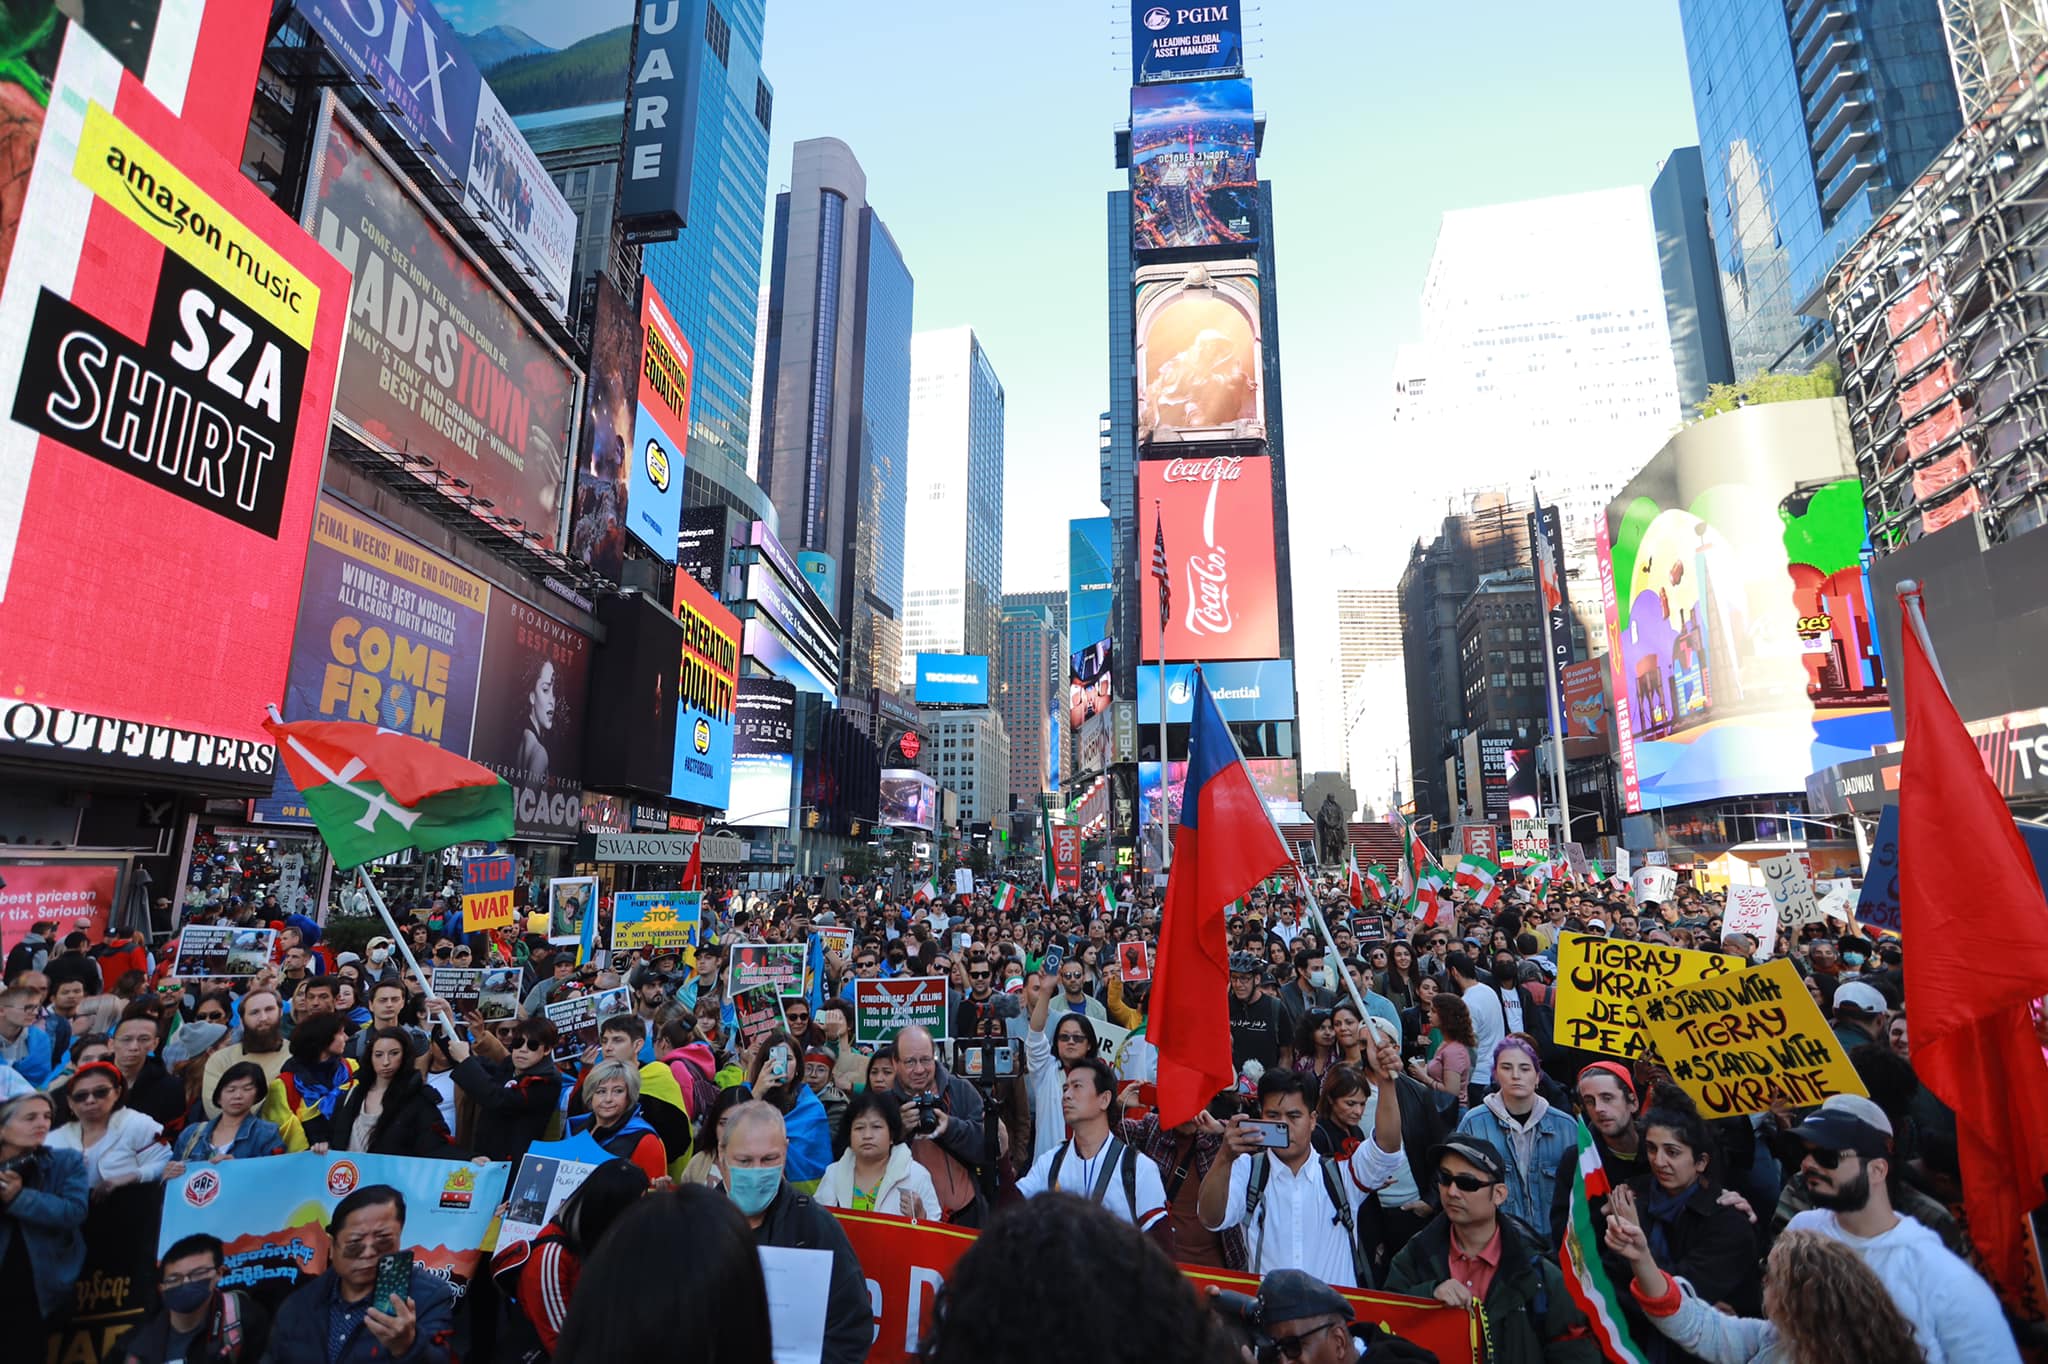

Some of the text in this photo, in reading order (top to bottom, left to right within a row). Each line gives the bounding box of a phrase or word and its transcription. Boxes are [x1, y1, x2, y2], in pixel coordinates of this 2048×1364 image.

[1177, 6, 1228, 25] PGIM
[1153, 34, 1221, 48] A LEADING GLOBAL
[1155, 47, 1180, 58] ASSET
[365, 45, 383, 77] THE
[388, 75, 428, 131] MUSICAL
[107, 145, 301, 314] amazon music
[532, 222, 568, 281] WRONG
[360, 216, 499, 366] COME SEE HOW THE WORLD COULD
[171, 289, 281, 422] SZA
[647, 321, 687, 393] GENERATION
[392, 351, 423, 386] TONY
[423, 380, 444, 406] AND
[644, 350, 685, 423] EQUALITY
[47, 331, 275, 511] SHIRT
[379, 365, 479, 461] BEST MUSICAL
[1164, 456, 1245, 483] Coca-Cola
[317, 511, 480, 602] FINAL WEEKS! MUST END OCTOBER 2
[342, 561, 456, 631] WINNER! BEST MUSICAL
[337, 584, 455, 647] ALL ACROSS NORTH AMERICA
[511, 603, 584, 651] BROADWAY'S
[515, 625, 574, 667] BEST BET
[679, 599, 737, 678] GENERATION
[329, 616, 451, 696] COME
[318, 662, 447, 742] FROM
[679, 650, 734, 726] QUALITY
[1211, 685, 1261, 700] udential
[4, 702, 275, 775] OUTFITTERS
[1119, 705, 1132, 761] HELLO!
[1481, 739, 1514, 747] EVERY
[1617, 698, 1637, 787] HERSHEY'S
[1483, 755, 1505, 763] DES
[1484, 762, 1491, 770] A
[512, 786, 580, 828] ICAGO
[637, 805, 668, 821] BLUE FIN
[1512, 819, 1548, 831] IMAGINE
[1526, 830, 1533, 839] A
[598, 839, 694, 856] SWAROVSK
[1060, 829, 1076, 863] tkts
[1471, 829, 1491, 860] tkt
[1513, 838, 1549, 849] BETTER
[467, 861, 511, 883] STOP
[1767, 858, 1793, 879] زن
[8, 904, 98, 921] tix. Seriously.
[36, 890, 79, 906] prices
[79, 891, 96, 901] on
[470, 898, 509, 921] WAR
[1778, 897, 1819, 923] آزادی
[643, 911, 676, 922] STOP
[1699, 954, 1729, 979] &
[881, 1007, 889, 1015] OF
[891, 1006, 914, 1015] KACHIN
[915, 1005, 937, 1014] PEOPLE
[893, 994, 905, 1003] SAC
[920, 992, 942, 1001] KILLING
[1586, 997, 1649, 1030] DES
[1646, 973, 1782, 1022] #STAND WITH
[863, 1018, 880, 1027] FROM
[1673, 1033, 1832, 1082] #STAND WITH
